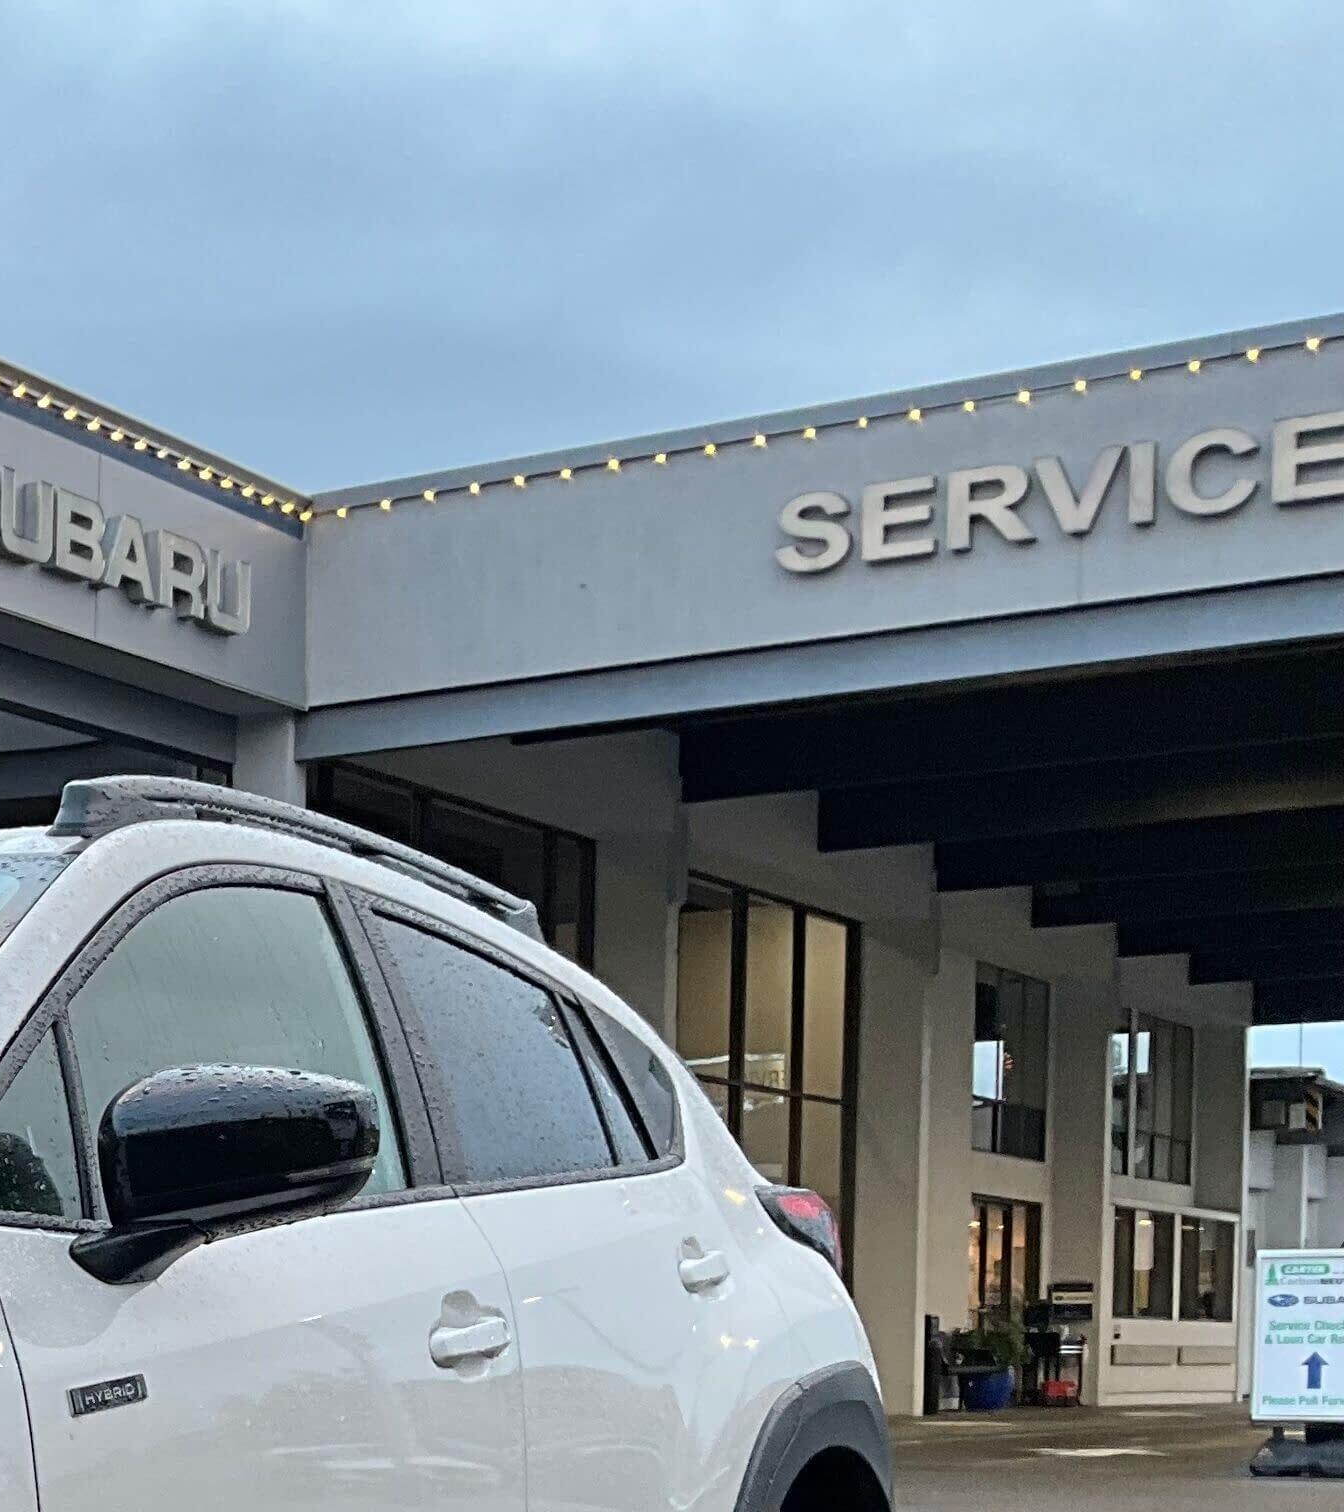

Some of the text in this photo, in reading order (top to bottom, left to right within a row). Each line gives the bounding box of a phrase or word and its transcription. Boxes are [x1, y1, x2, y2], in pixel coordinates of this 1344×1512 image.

[776, 411, 1344, 573] SERVICE
[1269, 1320, 1344, 1330] Service Chec
[1308, 1334, 1325, 1344] Car
[84, 1382, 135, 1405] HYBRID
